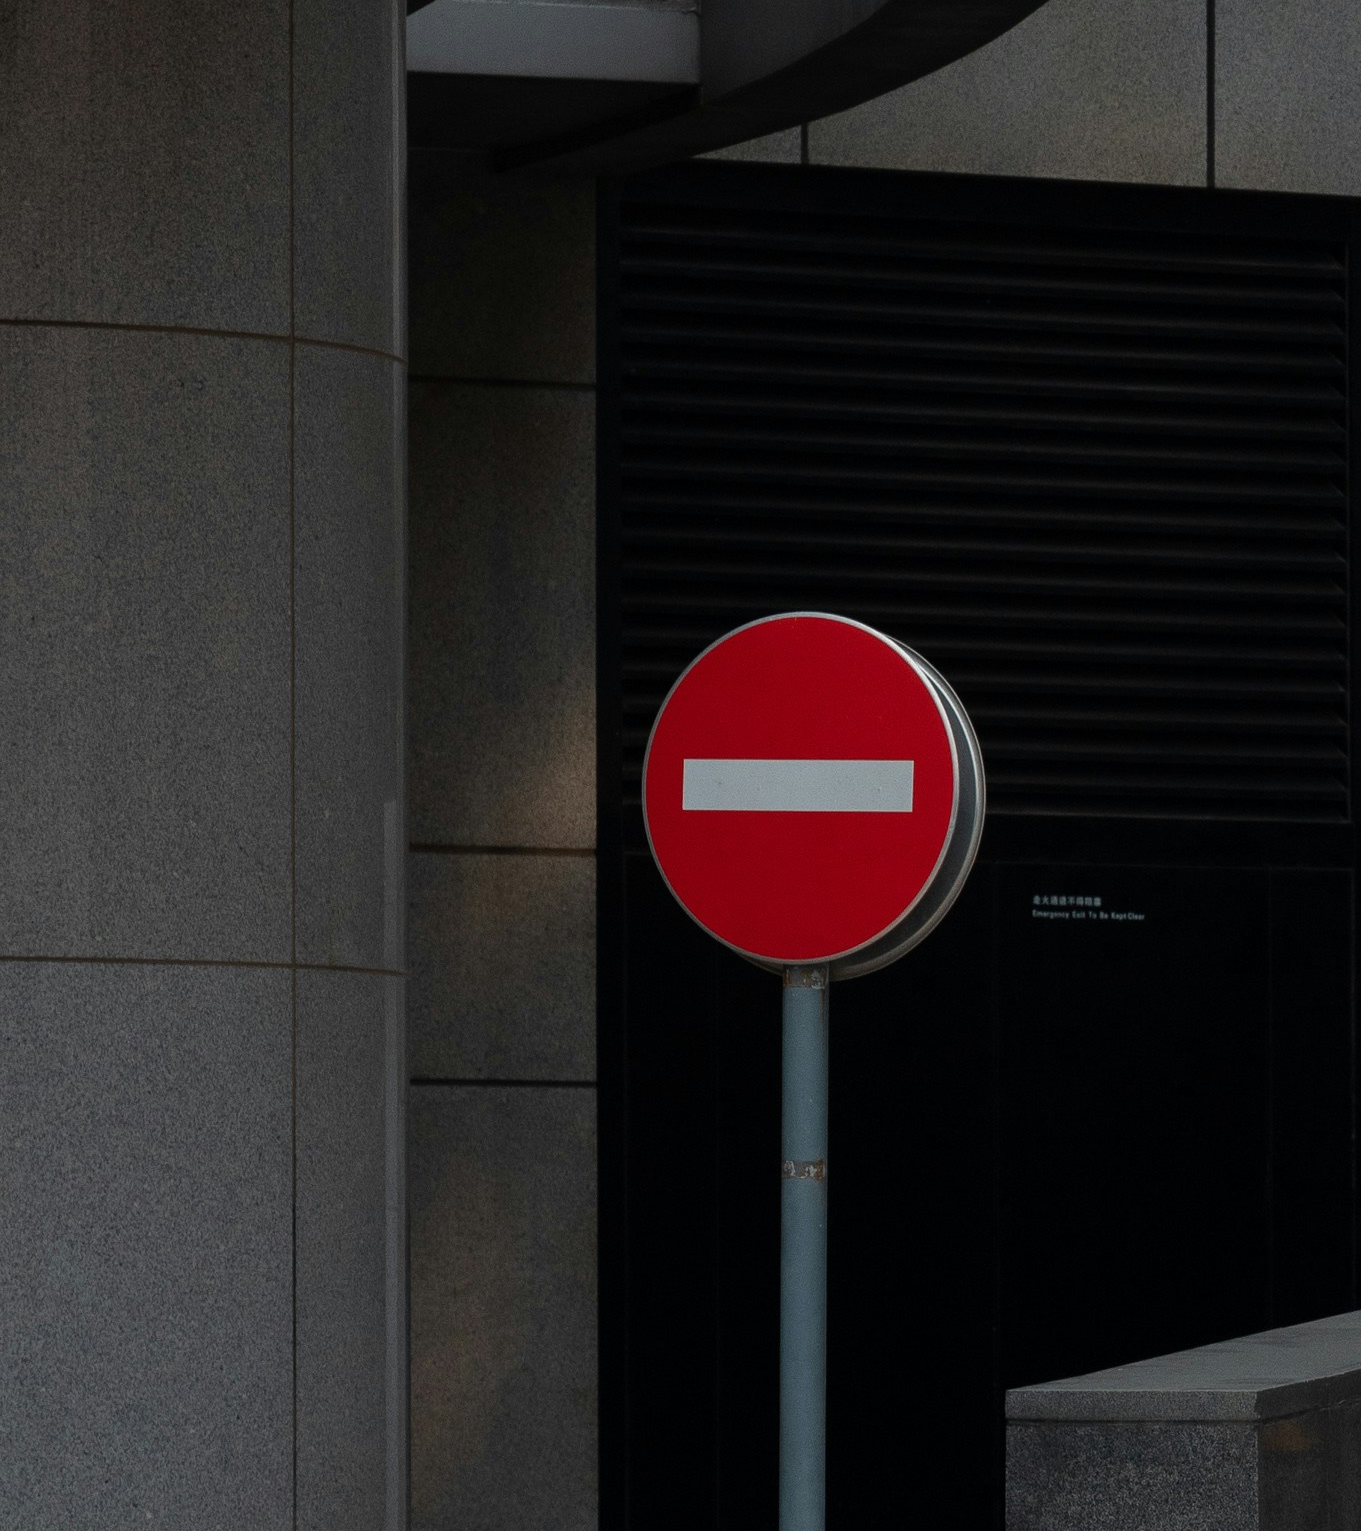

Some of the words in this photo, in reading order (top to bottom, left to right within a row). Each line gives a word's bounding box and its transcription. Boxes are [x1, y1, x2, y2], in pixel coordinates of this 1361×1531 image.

[1031, 908, 1069, 919] Emergency
[1071, 910, 1086, 919] Exit
[1088, 911, 1097, 919] To
[1099, 911, 1109, 919] Be
[1127, 912, 1145, 921] Clear
